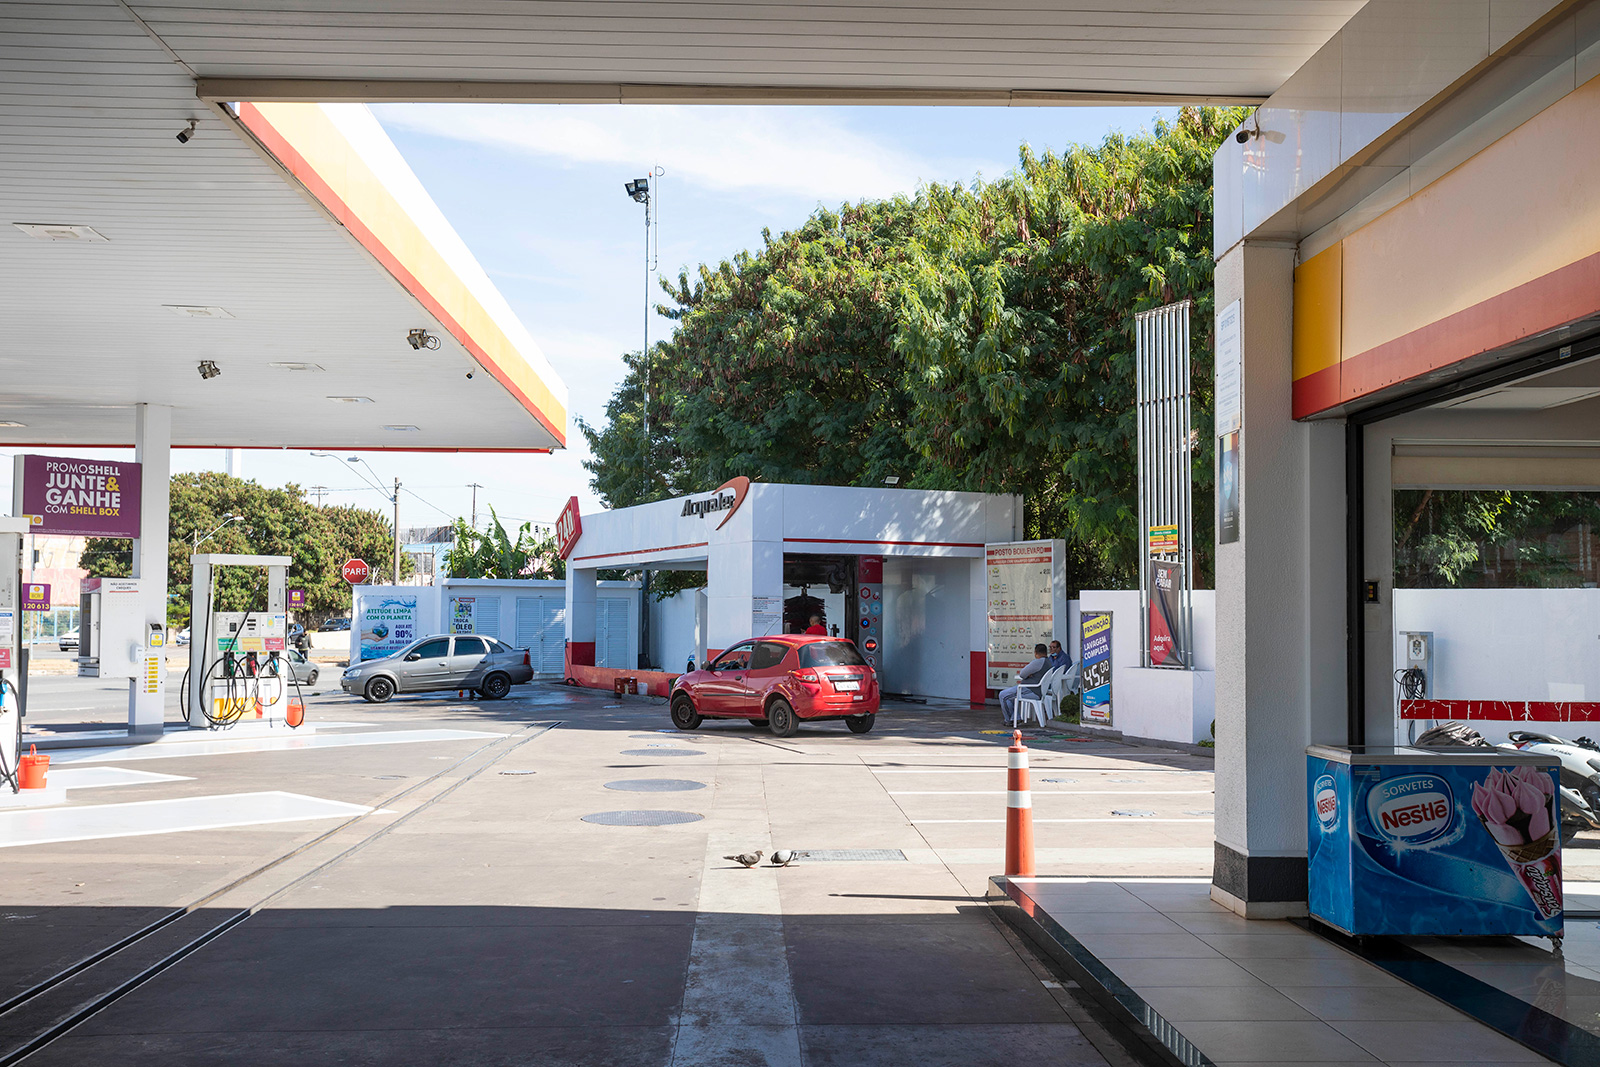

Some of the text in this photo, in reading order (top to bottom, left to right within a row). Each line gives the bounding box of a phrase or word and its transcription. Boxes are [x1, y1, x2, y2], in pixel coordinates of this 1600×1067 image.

[46, 462, 120, 476] PROMOSHELL
[45, 473, 120, 492] JUNTE&
[46, 488, 120, 508] GANHE
[45, 504, 120, 516] COM SHELL BOX
[558, 508, 574, 549] 24h
[994, 546, 1044, 556] POSTO BOULEVARD
[1085, 618, 1108, 633] PROMOÇÃO
[395, 630, 412, 638] 90%
[1084, 636, 1106, 651] LAVAGEM
[1084, 644, 1109, 660] COMPLETA
[1383, 780, 1434, 798] SORVETES
[1382, 800, 1447, 830] Nestlé
